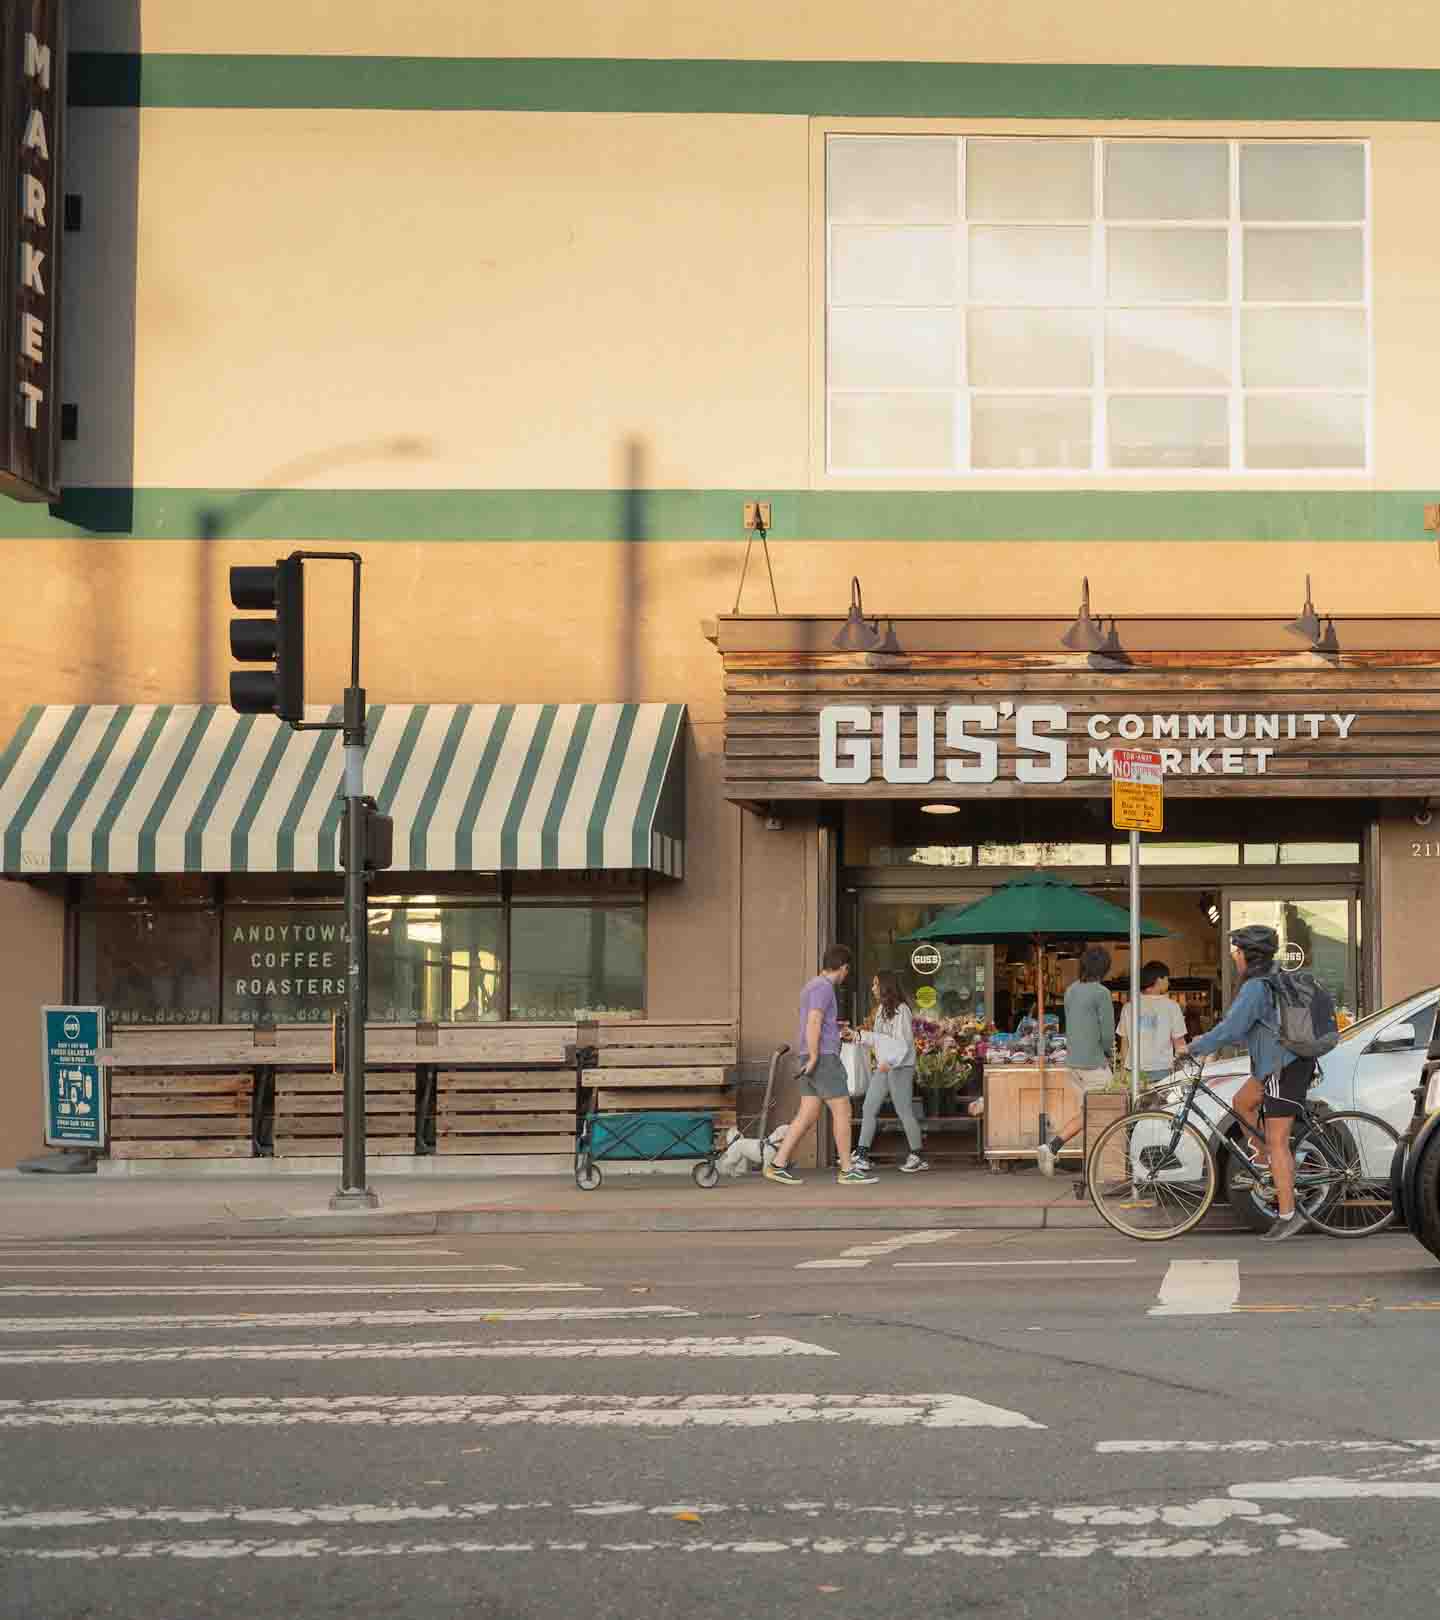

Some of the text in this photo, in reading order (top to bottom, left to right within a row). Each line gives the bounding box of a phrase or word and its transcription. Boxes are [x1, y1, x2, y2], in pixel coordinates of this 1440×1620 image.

[19, 32, 50, 429] MARKET
[1088, 713, 1356, 740] COMMUNITY
[819, 702, 1069, 784] GUS'S
[1088, 747, 1274, 775] MRKET
[1114, 760, 1130, 777] NO
[250, 952, 333, 968] COFFEE
[236, 979, 345, 995] ROASTERS
